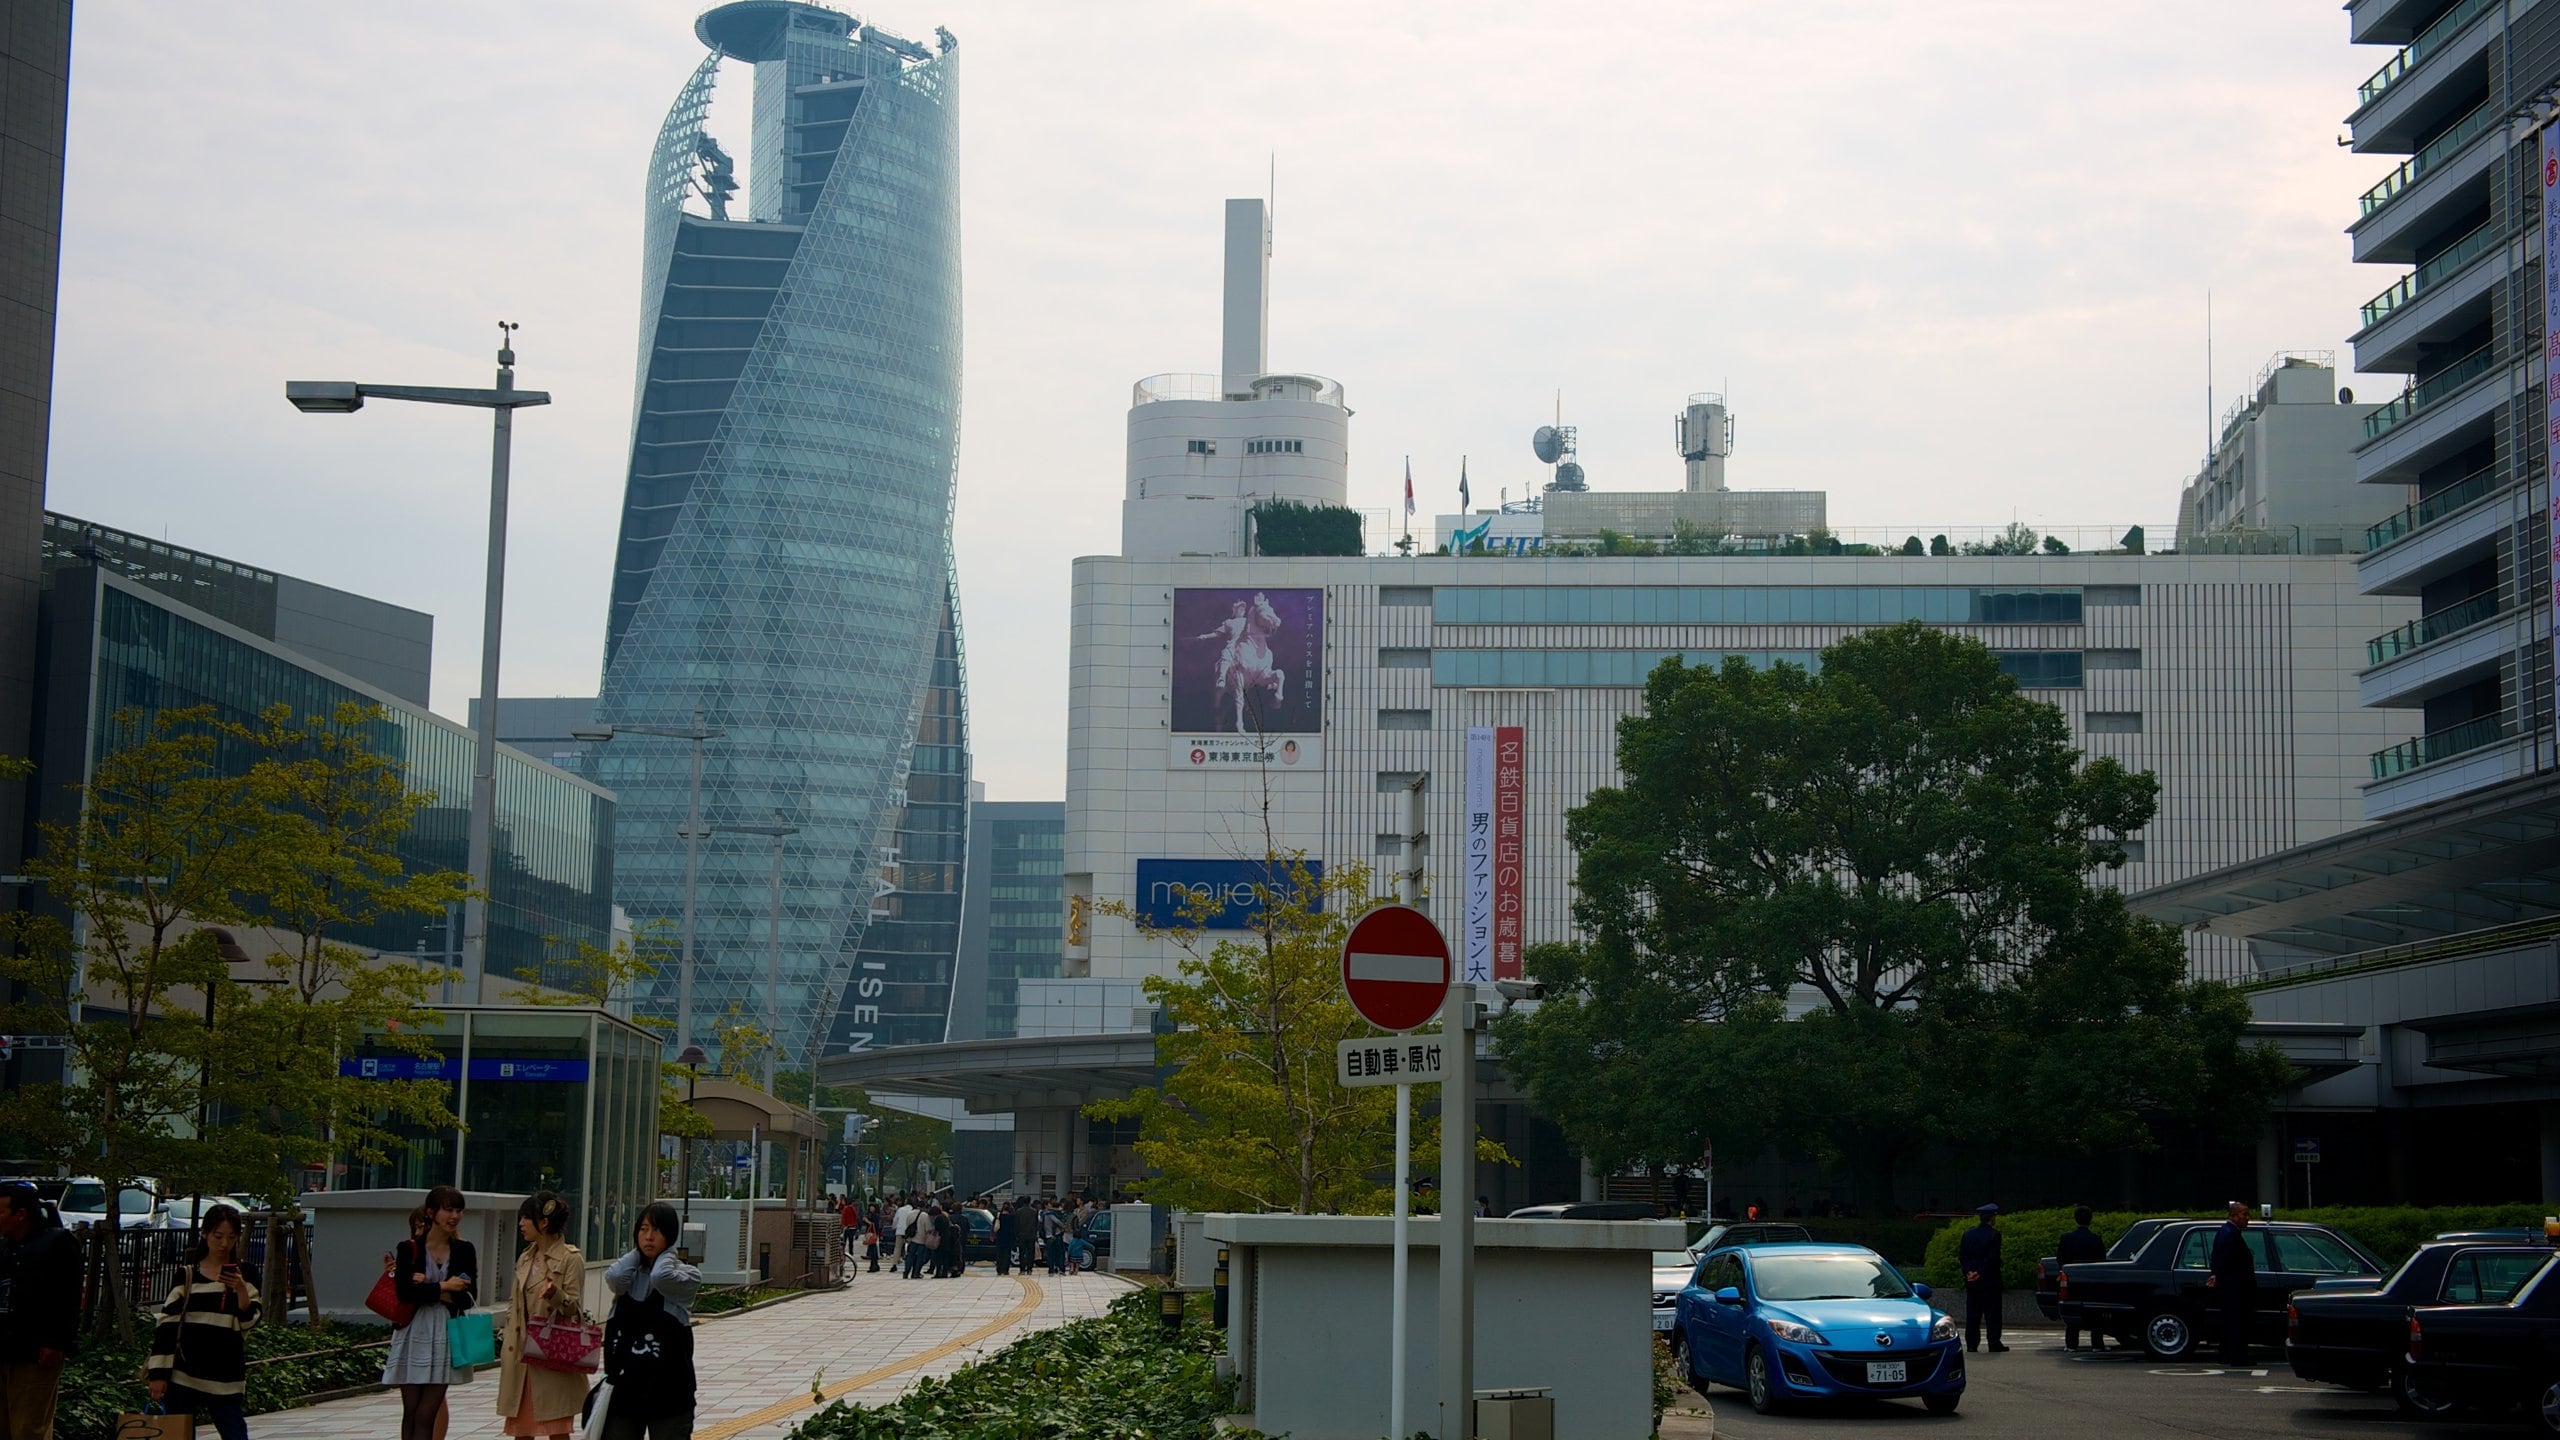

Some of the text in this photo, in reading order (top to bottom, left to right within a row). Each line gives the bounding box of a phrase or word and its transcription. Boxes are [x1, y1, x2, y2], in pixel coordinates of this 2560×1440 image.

[867, 847, 900, 927] HAL
[1498, 741, 1520, 963] 名鉄百貨店のお歳暮
[1468, 812, 1489, 982] 男のファッション大
[849, 962, 886, 1053] ISEN
[515, 1063, 559, 1073] エレベーター
[1347, 1044, 1442, 1077] 自動車・原付
[1876, 1369, 1905, 1381] 71-05
